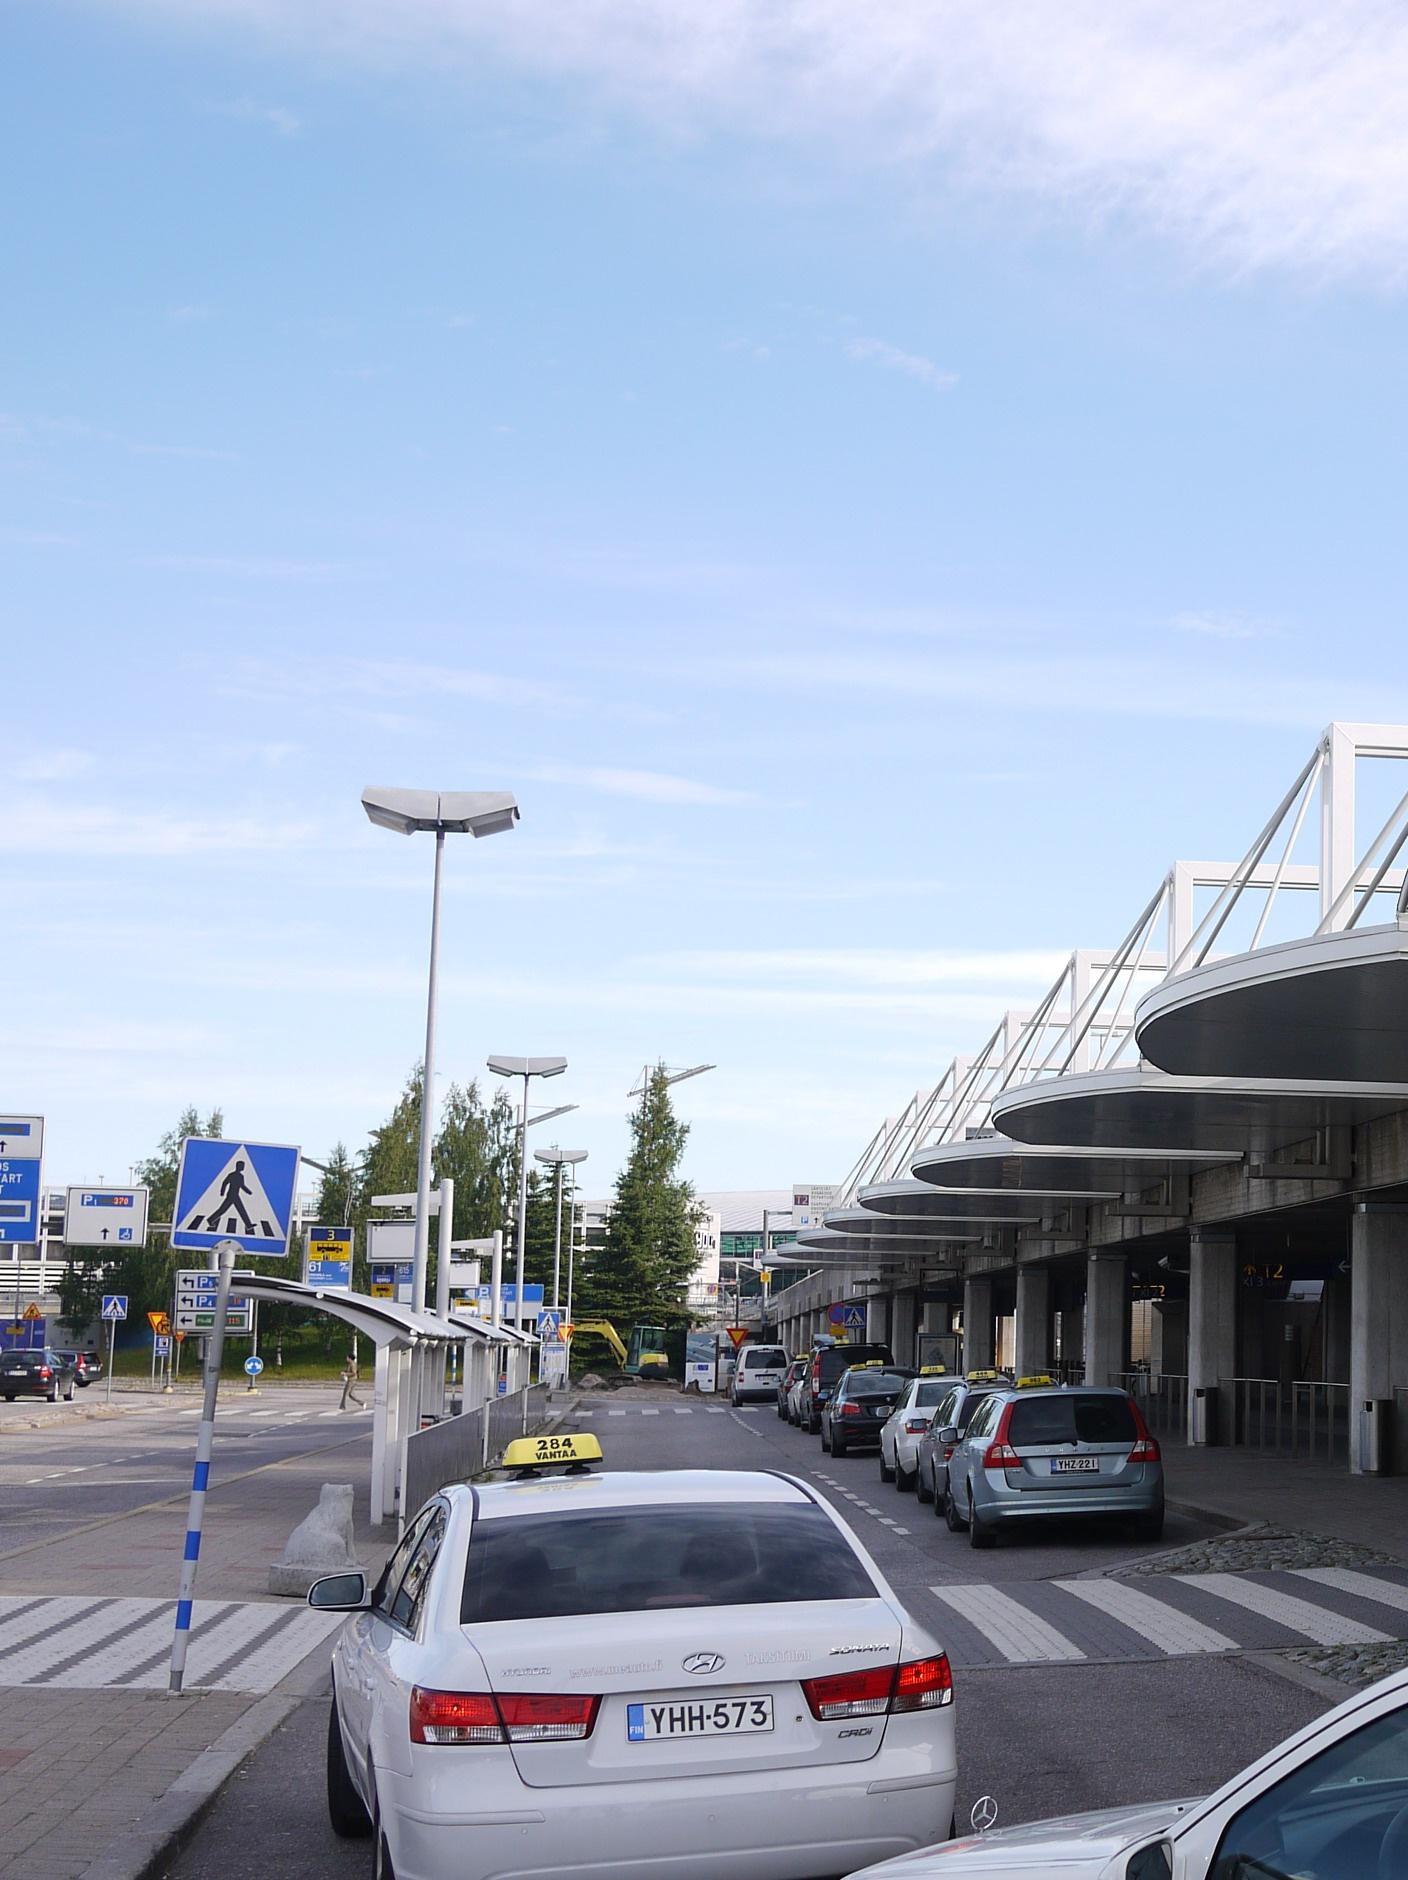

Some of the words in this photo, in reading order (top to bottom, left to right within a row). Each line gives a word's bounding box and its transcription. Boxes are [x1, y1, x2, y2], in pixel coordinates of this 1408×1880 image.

[327, 1230, 335, 1241] 3
[309, 1261, 322, 1272] 61
[537, 1438, 573, 1451] 284
[535, 1449, 577, 1461] VANTAA
[829, 1642, 890, 1656] SONATA
[629, 1726, 644, 1735] FIN
[651, 1700, 767, 1734] YHH-573
